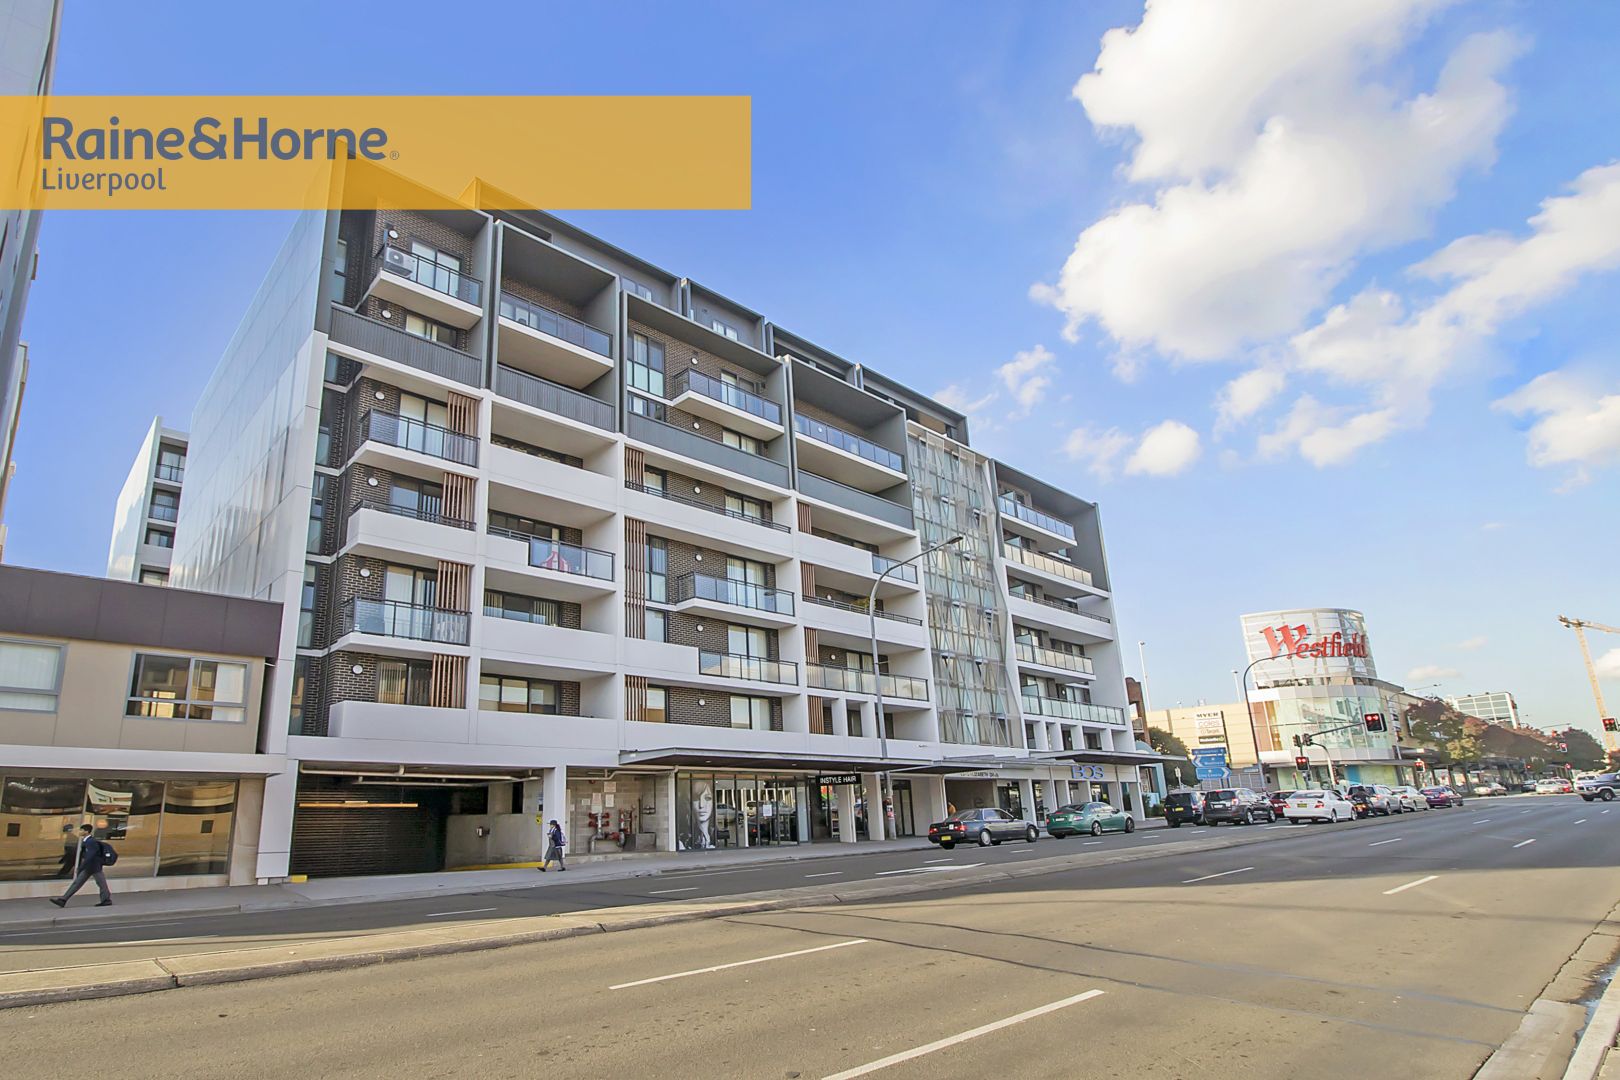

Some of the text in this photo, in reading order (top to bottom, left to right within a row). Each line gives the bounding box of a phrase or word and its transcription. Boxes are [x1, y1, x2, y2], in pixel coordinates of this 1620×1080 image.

[1259, 624, 1368, 660] Westfield
[820, 775, 856, 784] INSTYLE HAIR
